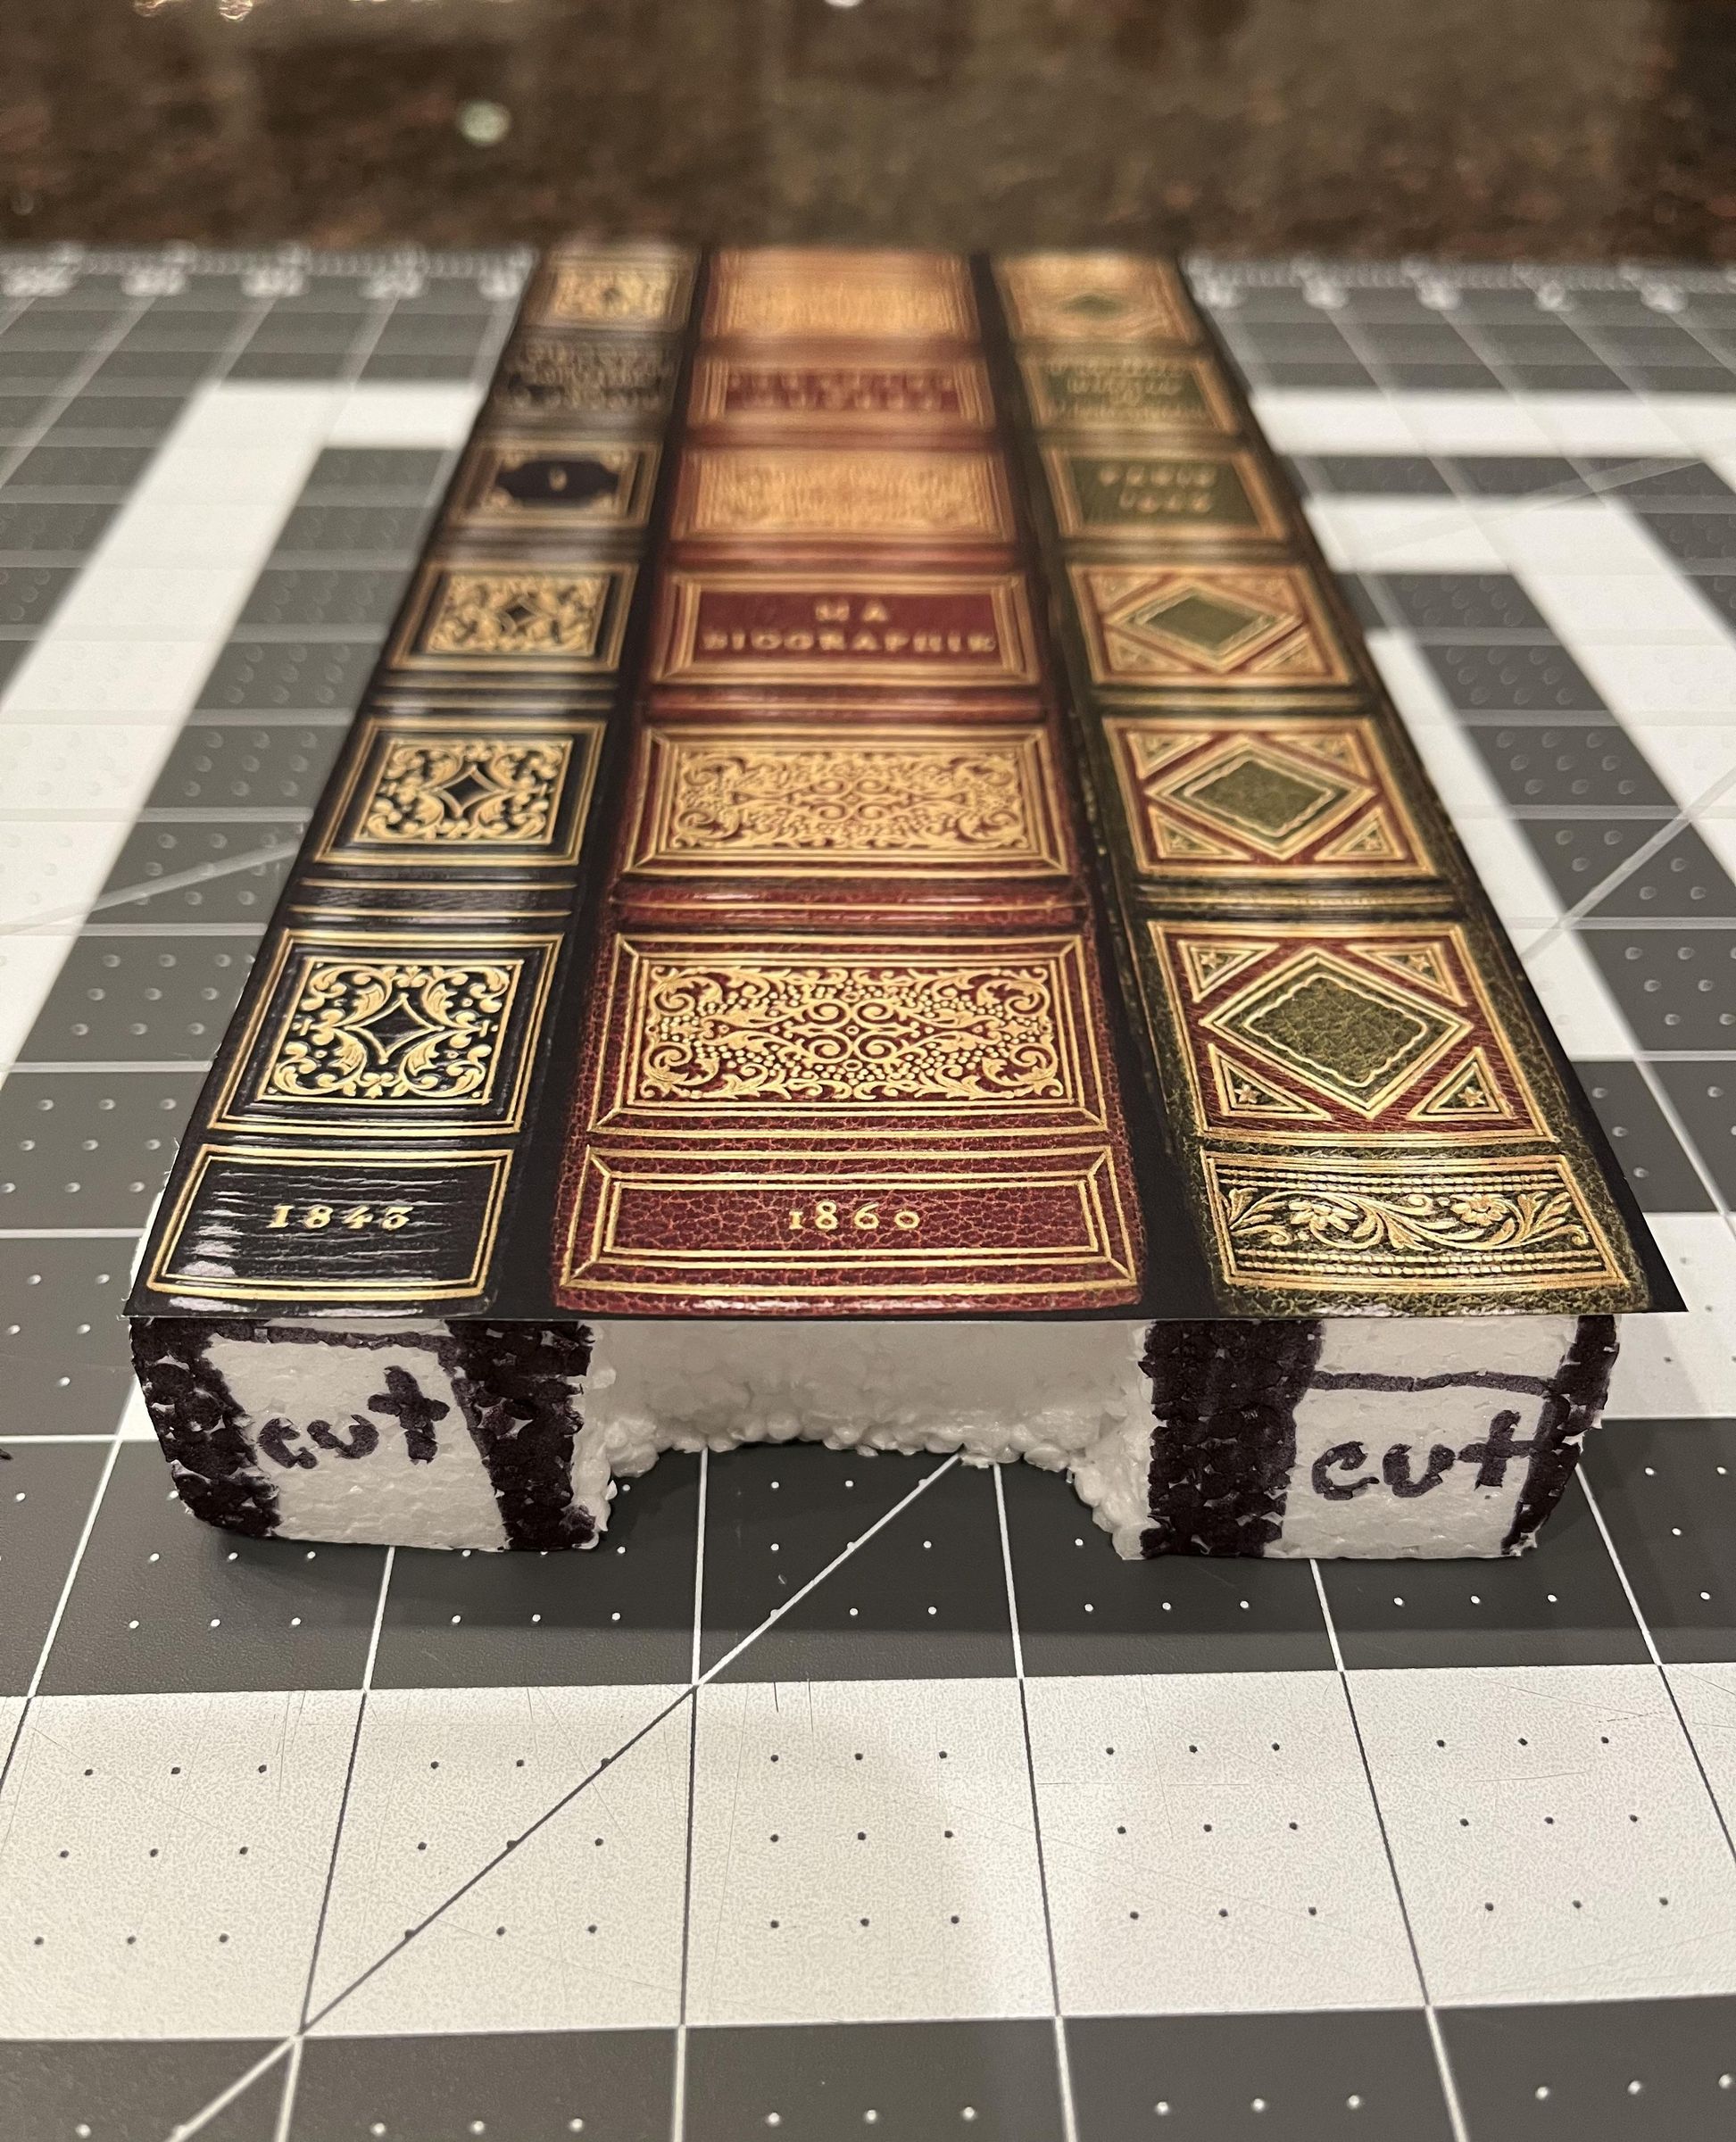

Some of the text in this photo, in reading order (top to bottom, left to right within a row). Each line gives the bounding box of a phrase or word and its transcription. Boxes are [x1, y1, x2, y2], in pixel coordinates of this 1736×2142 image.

[788, 1200, 921, 1231] 1860
[259, 1365, 450, 1470] cut
[1311, 1409, 1535, 1501] cut
